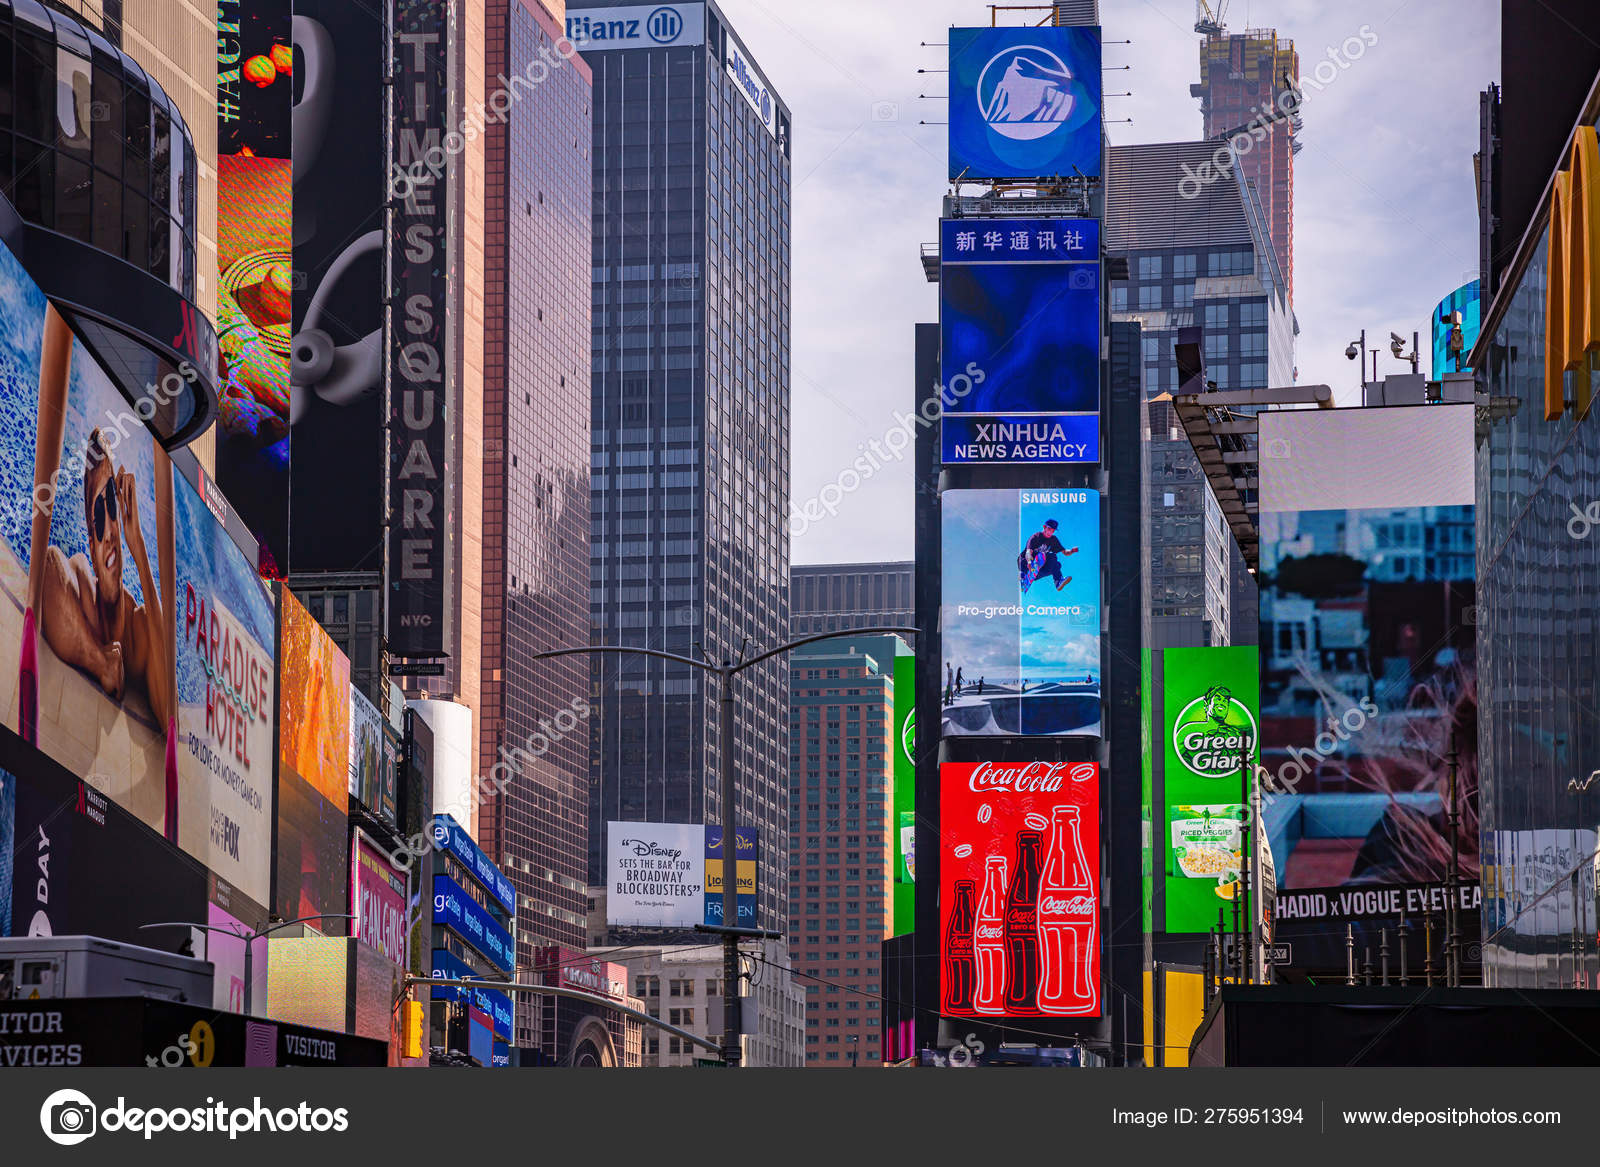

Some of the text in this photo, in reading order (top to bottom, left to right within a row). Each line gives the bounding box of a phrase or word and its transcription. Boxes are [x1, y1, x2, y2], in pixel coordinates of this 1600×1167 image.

[956, 230, 1084, 251] 新华通讯社
[398, 33, 442, 579] TIMES SQUARE
[975, 423, 1066, 442] XINHUA
[955, 444, 1087, 458] NEWS AGENCY
[1022, 493, 1087, 503] SAMSUNG
[401, 614, 432, 626] NYC
[958, 605, 1080, 619] Pro-grade Camera
[185, 580, 268, 724] PARADISE
[205, 681, 250, 770] HOTEL
[1184, 732, 1251, 750] Green
[188, 732, 199, 760] FOR
[214, 755, 221, 777] OR
[224, 815, 240, 862] FOX
[37, 824, 50, 904] DAY
[619, 858, 691, 870] SETS THE BAR FOR
[626, 869, 684, 883] BROADWAY
[1276, 894, 1327, 919] HADID
[1341, 890, 1402, 915] VOGUE
[0, 1044, 82, 1066] VICES
[285, 1034, 337, 1061] VISITOR
